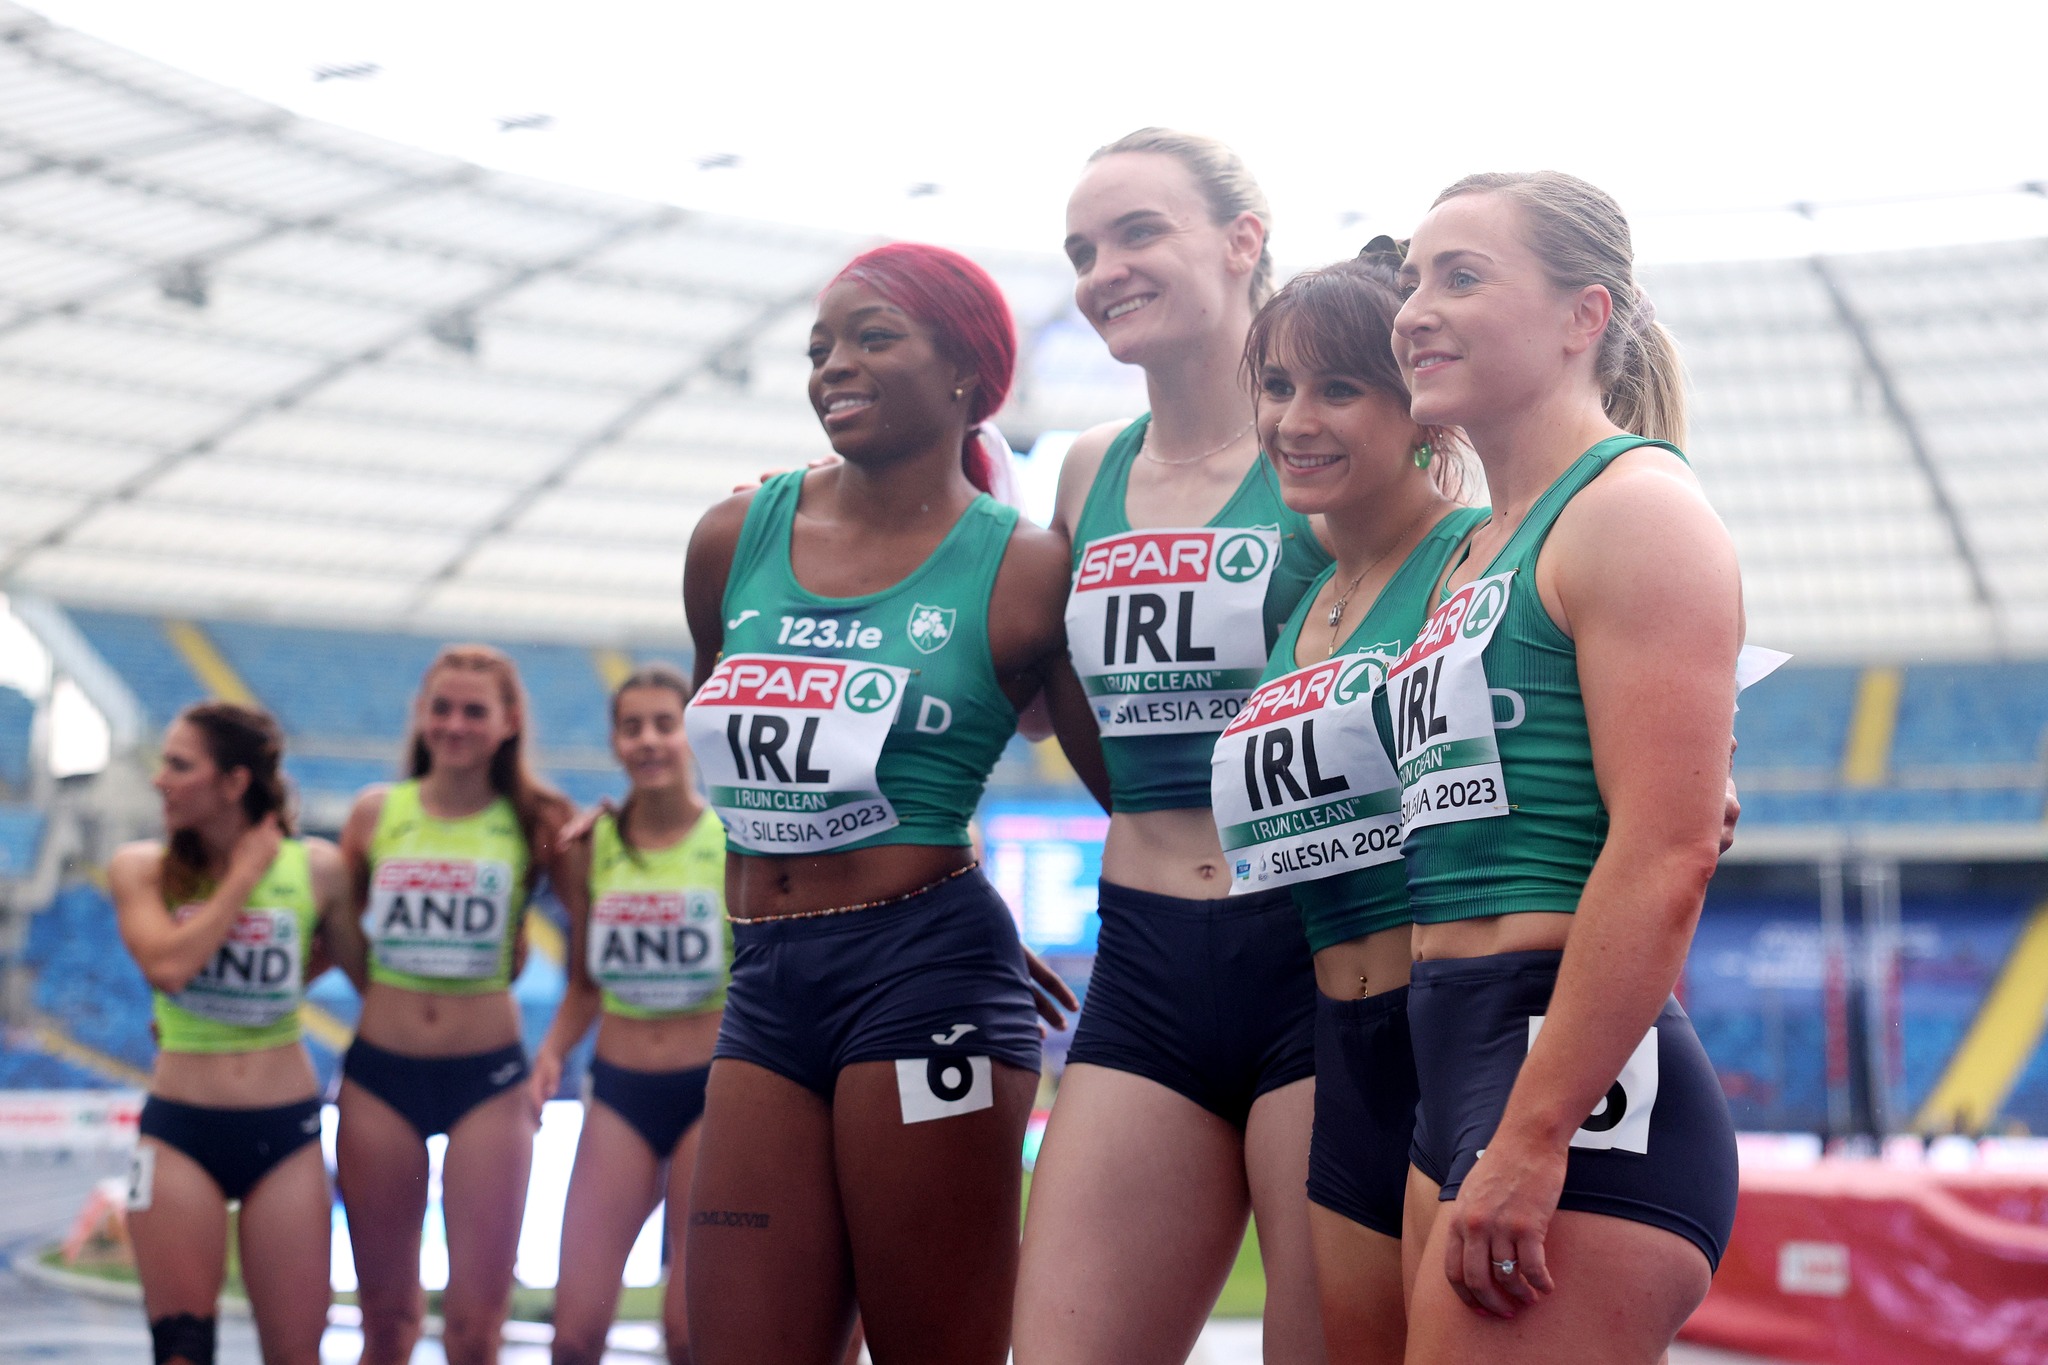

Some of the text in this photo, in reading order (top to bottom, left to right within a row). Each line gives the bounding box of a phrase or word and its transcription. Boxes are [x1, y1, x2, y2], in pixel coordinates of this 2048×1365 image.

[1081, 539, 1209, 585] SPAR
[777, 615, 883, 649] 123.ie
[1103, 591, 1216, 666] IRL
[699, 664, 839, 705] SPAR
[1229, 668, 1330, 730] SPAR
[1115, 698, 1249, 724] SILESIA 20
[1398, 655, 1447, 760] IRL
[727, 714, 830, 783] IRL
[1244, 718, 1350, 812] IRL
[735, 789, 740, 806] I
[742, 790, 772, 808] RUN
[1436, 778, 1497, 810] 2023
[752, 805, 888, 842] SILESIA 2023
[1252, 823, 1259, 841] I
[1261, 817, 1292, 840] RUN
[1271, 824, 1402, 874] SILESIA 202
[384, 894, 497, 934] AND
[201, 945, 292, 985] ND
[601, 927, 710, 965] AND
